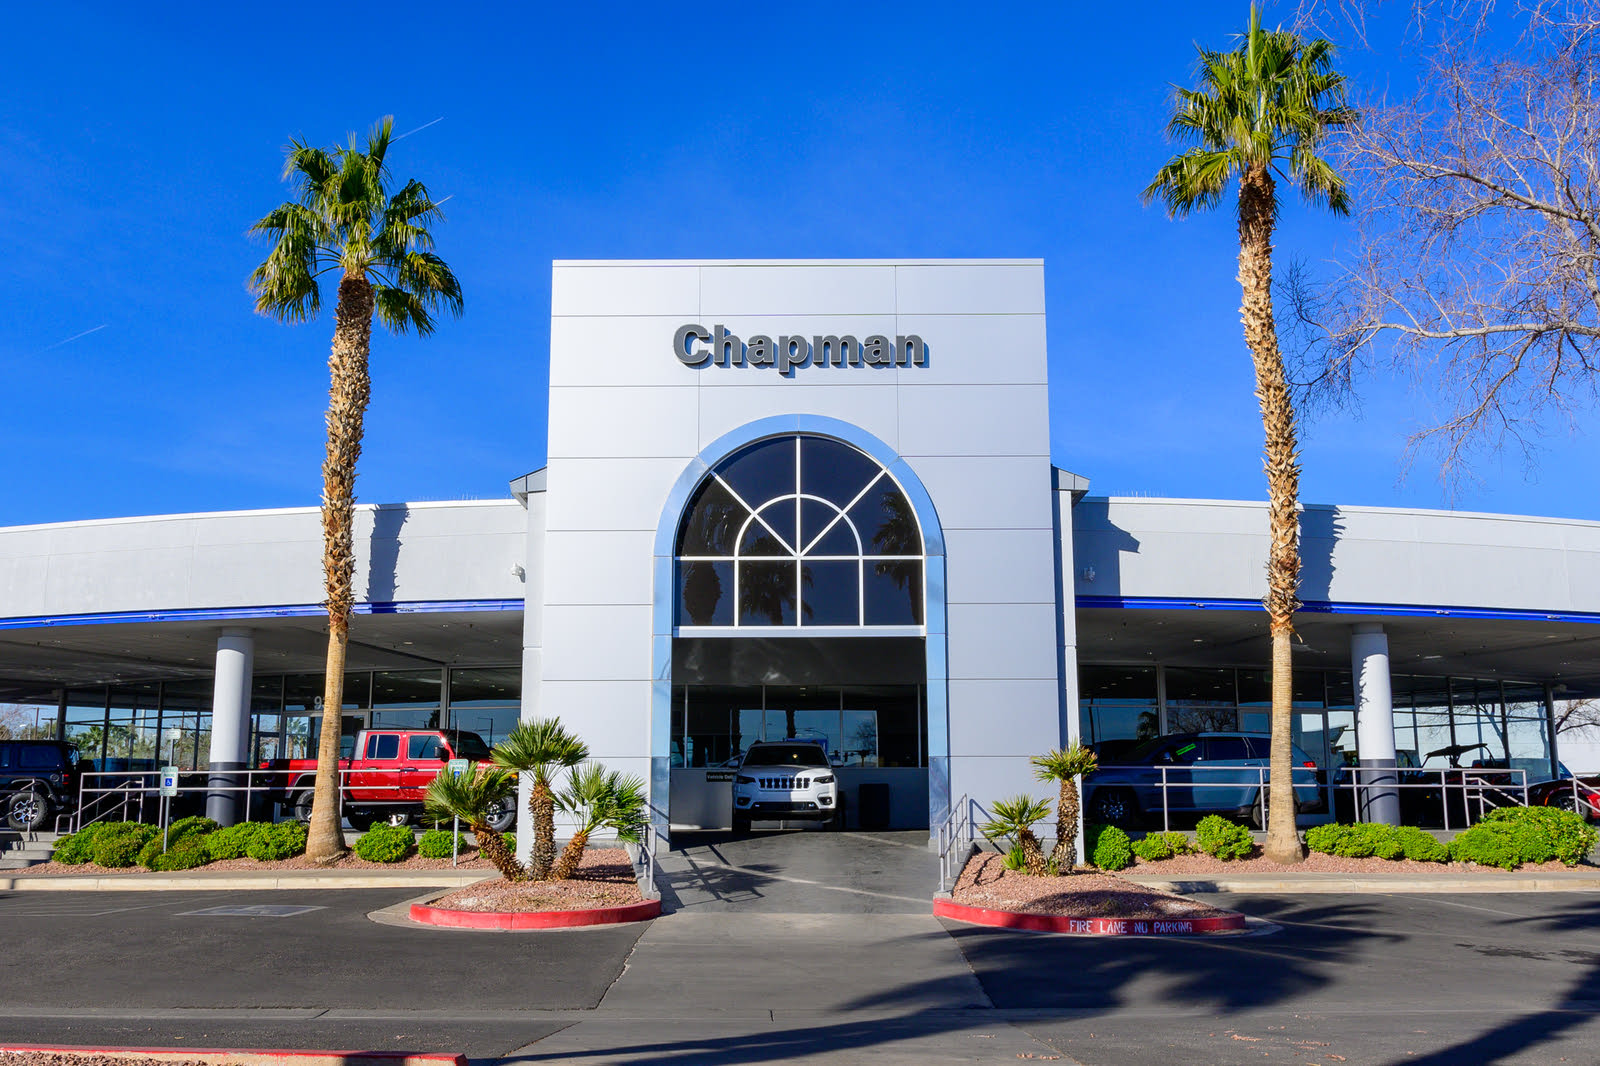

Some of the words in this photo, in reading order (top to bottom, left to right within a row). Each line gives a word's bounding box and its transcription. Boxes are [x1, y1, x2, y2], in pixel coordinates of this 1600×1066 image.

[672, 323, 926, 375] Chapman
[1069, 919, 1093, 933] FIRE
[1100, 921, 1128, 934] LANE
[1134, 921, 1148, 934] NO
[1154, 921, 1193, 933] PARKING
